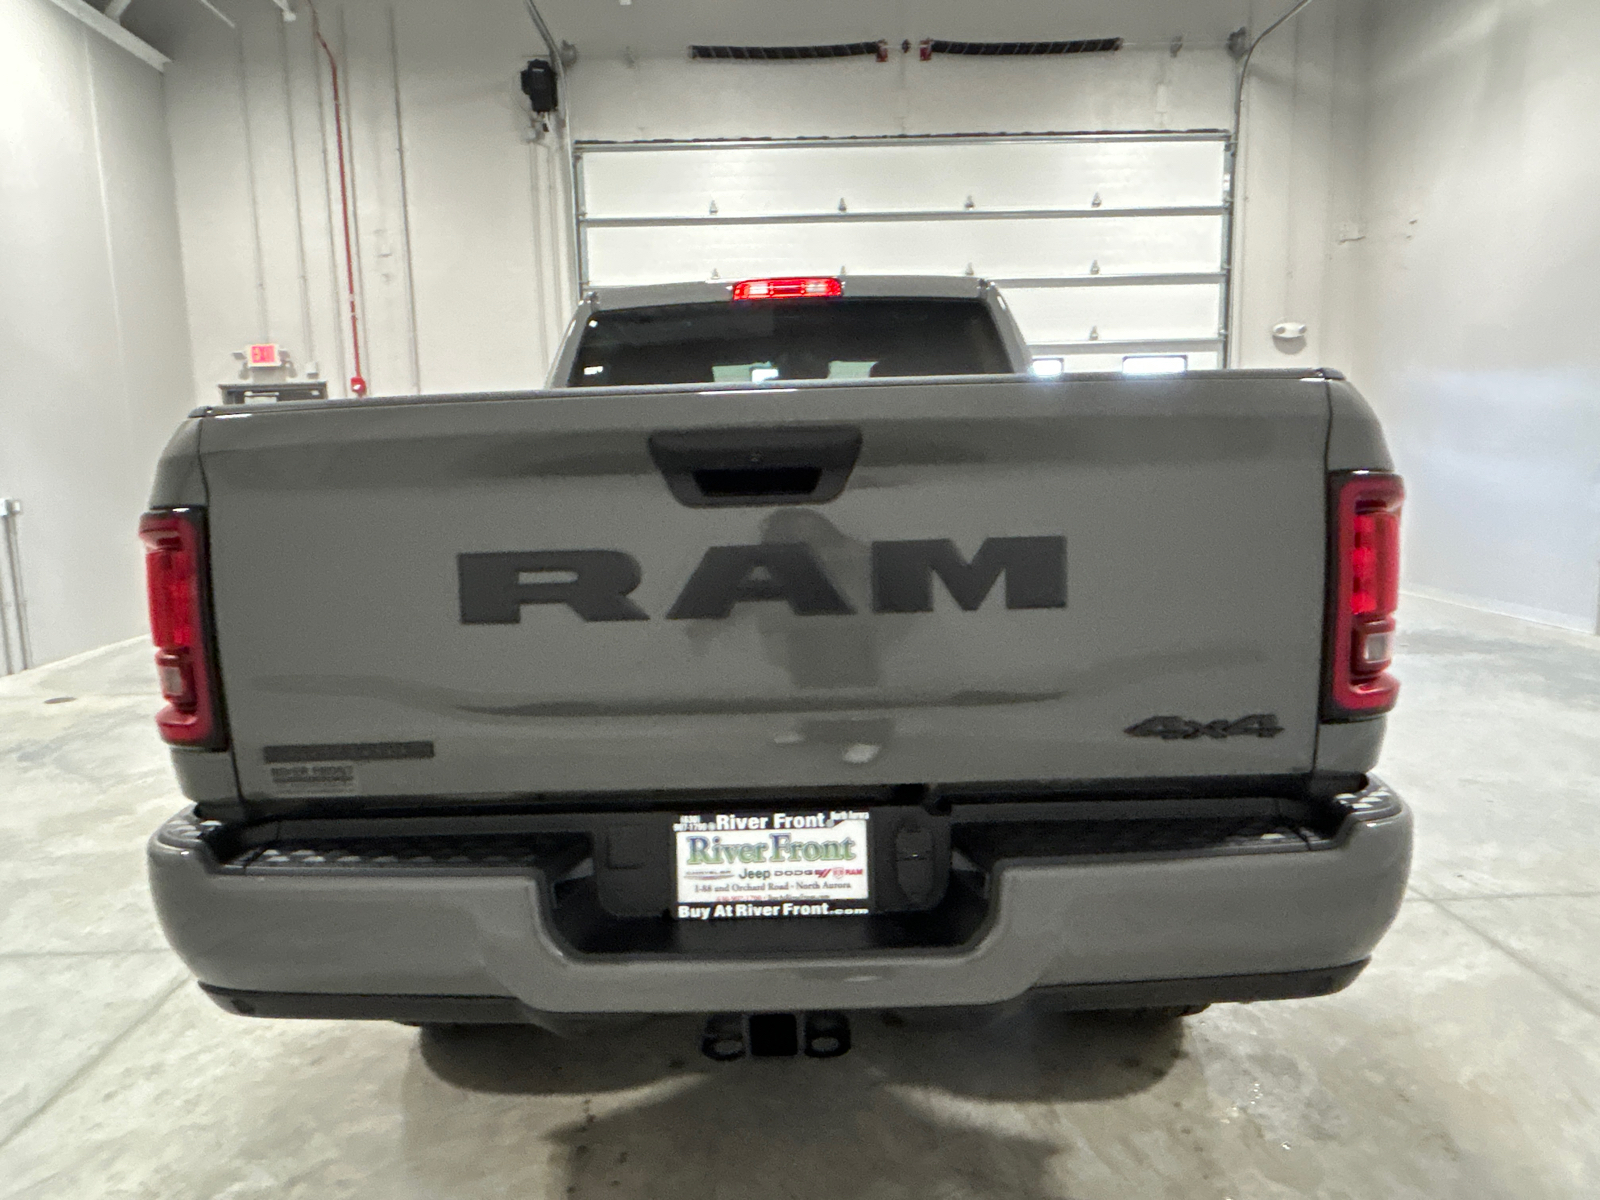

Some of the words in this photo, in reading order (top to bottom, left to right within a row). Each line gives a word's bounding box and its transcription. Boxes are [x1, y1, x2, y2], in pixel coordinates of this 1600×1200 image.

[457, 535, 1067, 625] RAM
[1123, 713, 1285, 740] 4x4
[715, 814, 769, 830] River
[773, 812, 825, 829] Front
[738, 867, 772, 881] Jeep
[845, 868, 864, 876] RAM
[714, 882, 731, 892] and
[731, 880, 767, 892] Orchard
[768, 880, 790, 891] Road
[795, 879, 821, 890] North
[822, 879, 853, 890] Aurora
[678, 904, 711, 920] Buy
[714, 904, 734, 917] At
[735, 903, 781, 917] River
